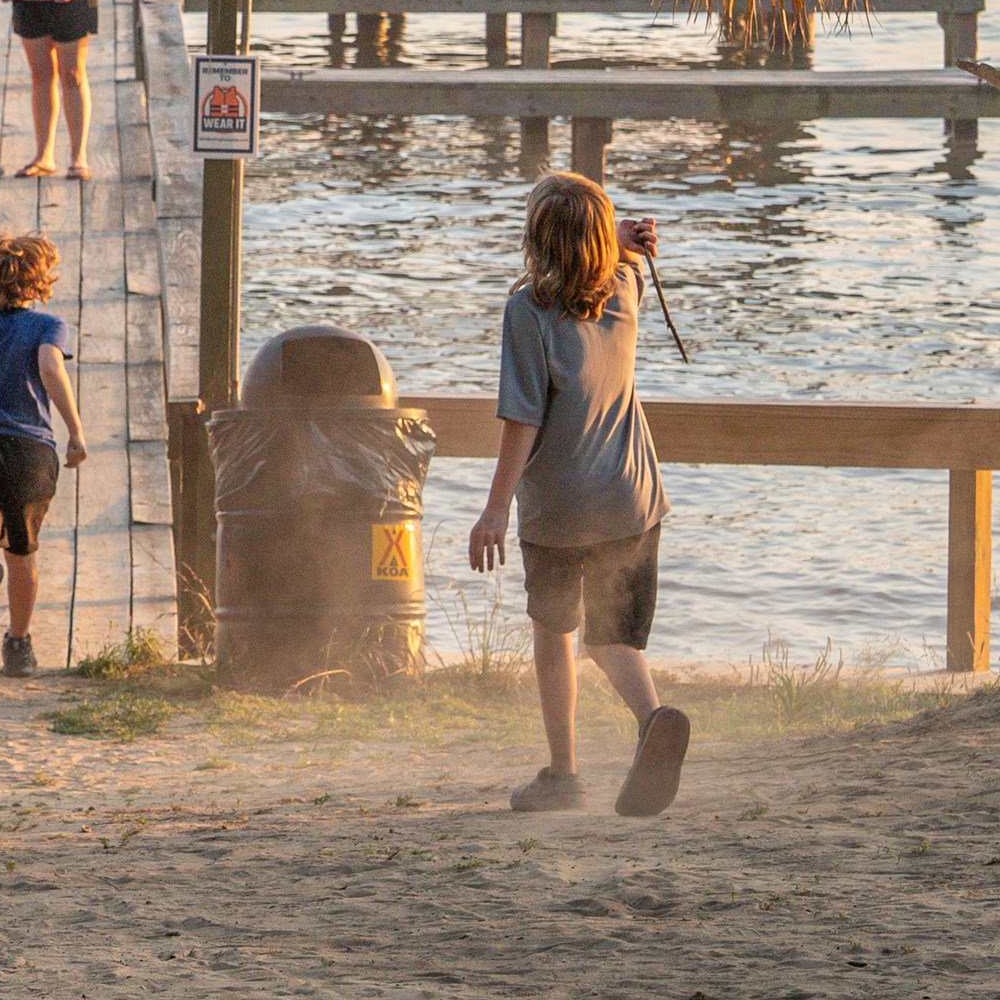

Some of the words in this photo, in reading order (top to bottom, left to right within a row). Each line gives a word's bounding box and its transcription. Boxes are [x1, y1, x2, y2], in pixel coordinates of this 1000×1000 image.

[203, 118, 234, 129] WEAR
[235, 119, 245, 129] IT
[377, 567, 408, 577] KOA
